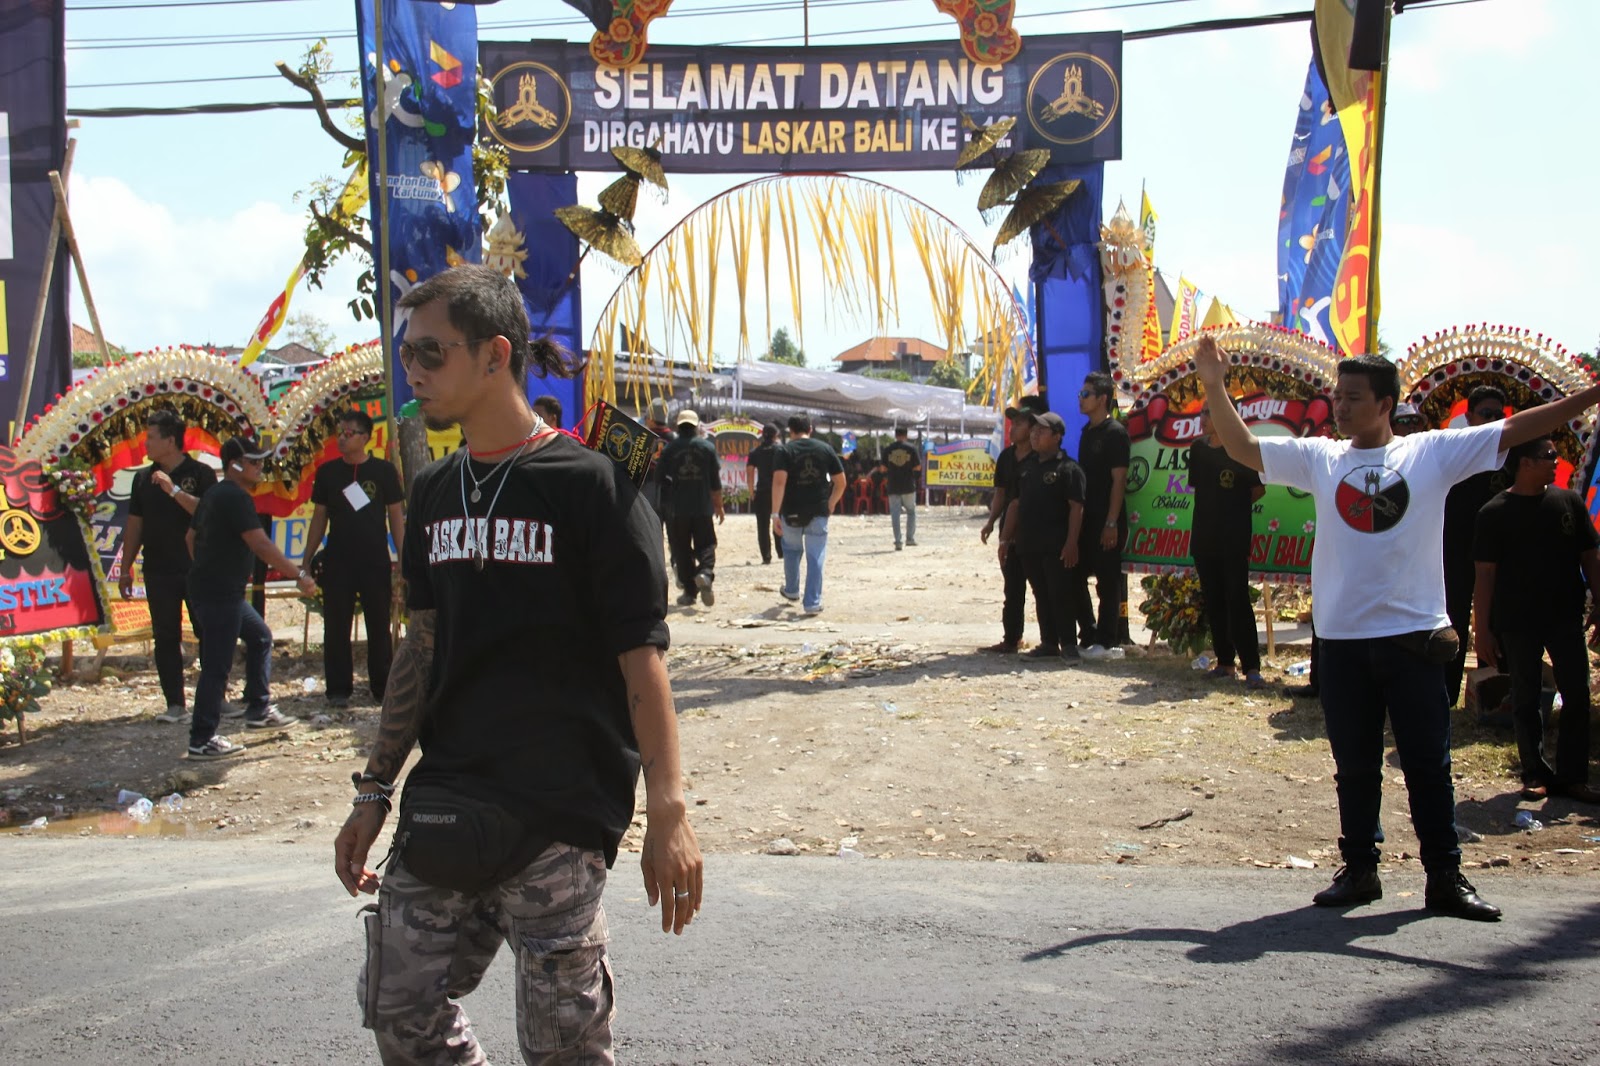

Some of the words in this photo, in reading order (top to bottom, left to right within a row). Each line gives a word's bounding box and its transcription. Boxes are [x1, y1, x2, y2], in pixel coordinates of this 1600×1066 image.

[594, 63, 804, 110] SELAMAT
[819, 58, 1004, 110] DATANG
[583, 119, 734, 155] DIRGAHAYU
[742, 120, 846, 155] LASKAR
[854, 119, 912, 153] BALI
[921, 117, 957, 151] KE
[939, 461, 980, 471] LASKAR
[939, 471, 959, 480] FAST
[425, 518, 489, 564] ASKAR
[494, 518, 553, 563] BALI
[1273, 535, 1315, 567] BALI
[0, 577, 71, 611] STIK
